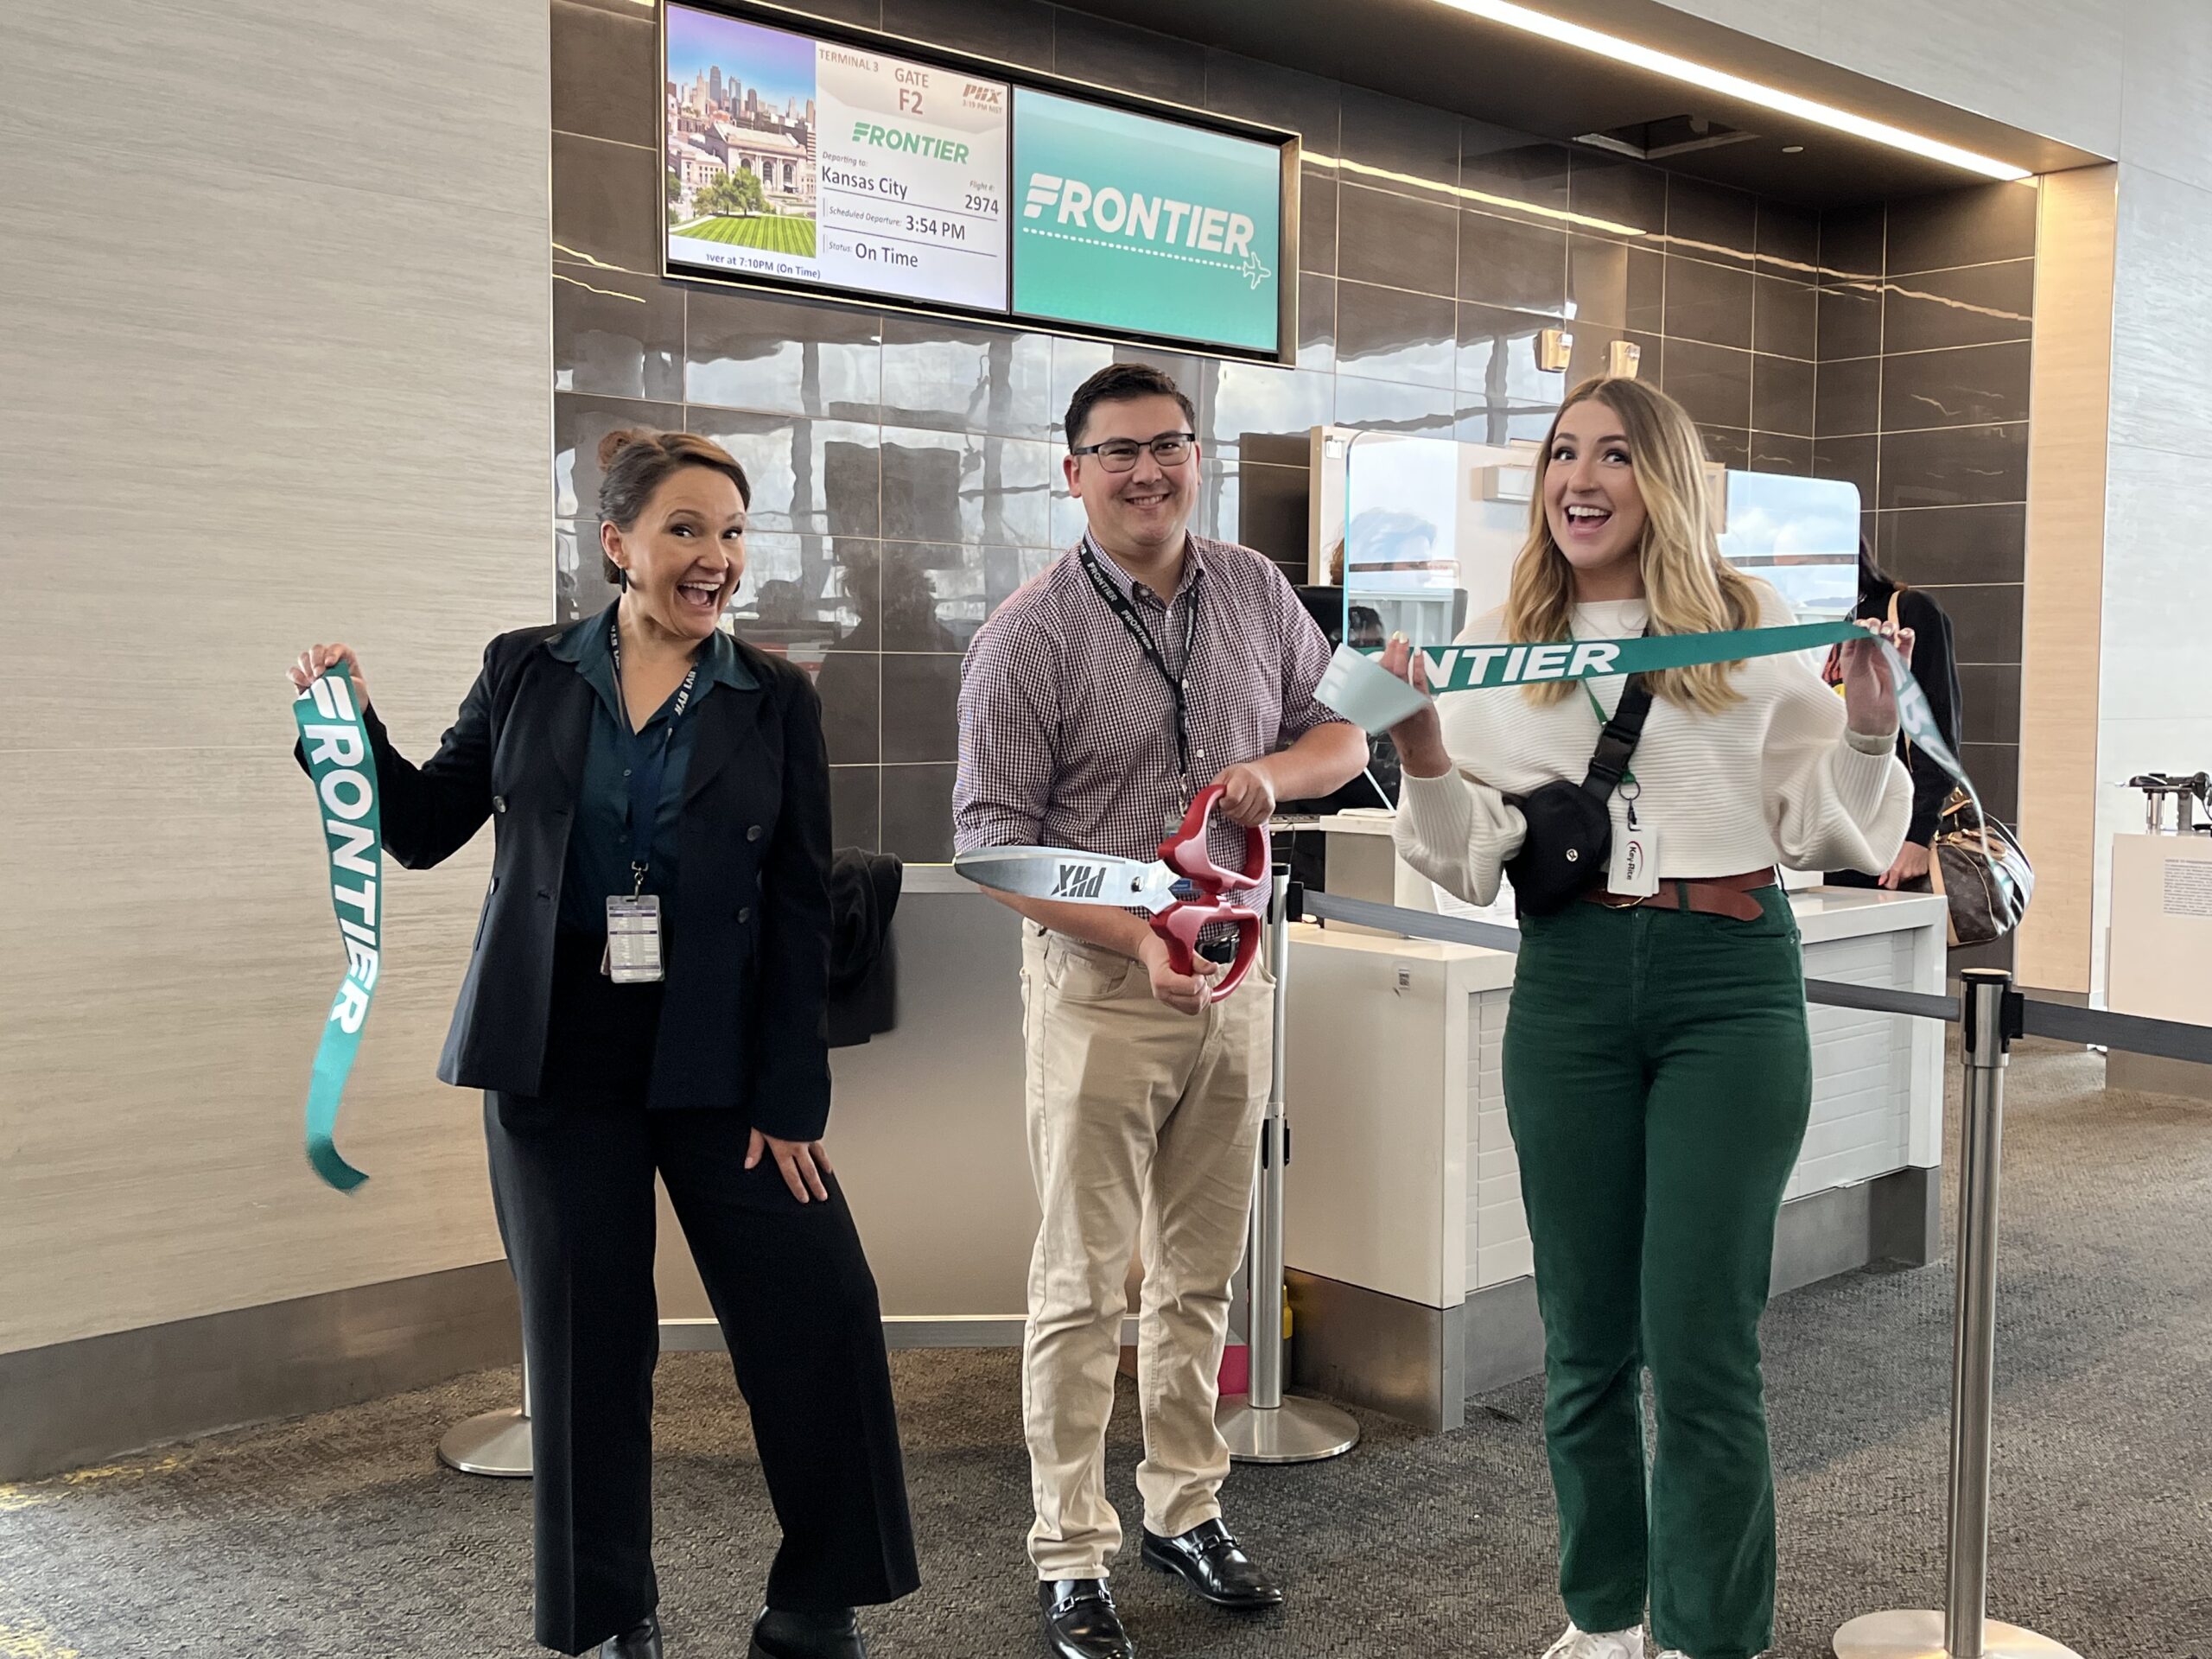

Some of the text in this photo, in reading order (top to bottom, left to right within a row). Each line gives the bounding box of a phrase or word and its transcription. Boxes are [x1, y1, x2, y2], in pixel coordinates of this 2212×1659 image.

[819, 49, 879, 73] TERMINAL 3
[894, 67, 929, 88] GATE
[899, 88, 924, 115] F2
[977, 103, 988, 111] PM
[852, 122, 969, 164] FRONTIER
[823, 151, 868, 168] Departing to:
[822, 166, 908, 200] Kansas City
[969, 180, 988, 192] Flight
[965, 194, 999, 214] 2974
[1023, 173, 1254, 257] FRONTIER
[829, 207, 965, 241] Scheduled Departure: 3:54 PM
[829, 241, 918, 268] Status: On Time
[728, 257, 737, 266] at
[740, 257, 774, 271] 7:10PM
[777, 264, 793, 275] (On
[796, 266, 821, 280] Time)
[1087, 562, 1118, 602] FRONTIER
[1121, 609, 1153, 650] FRONTIER
[297, 676, 379, 1034] FRONTIER
